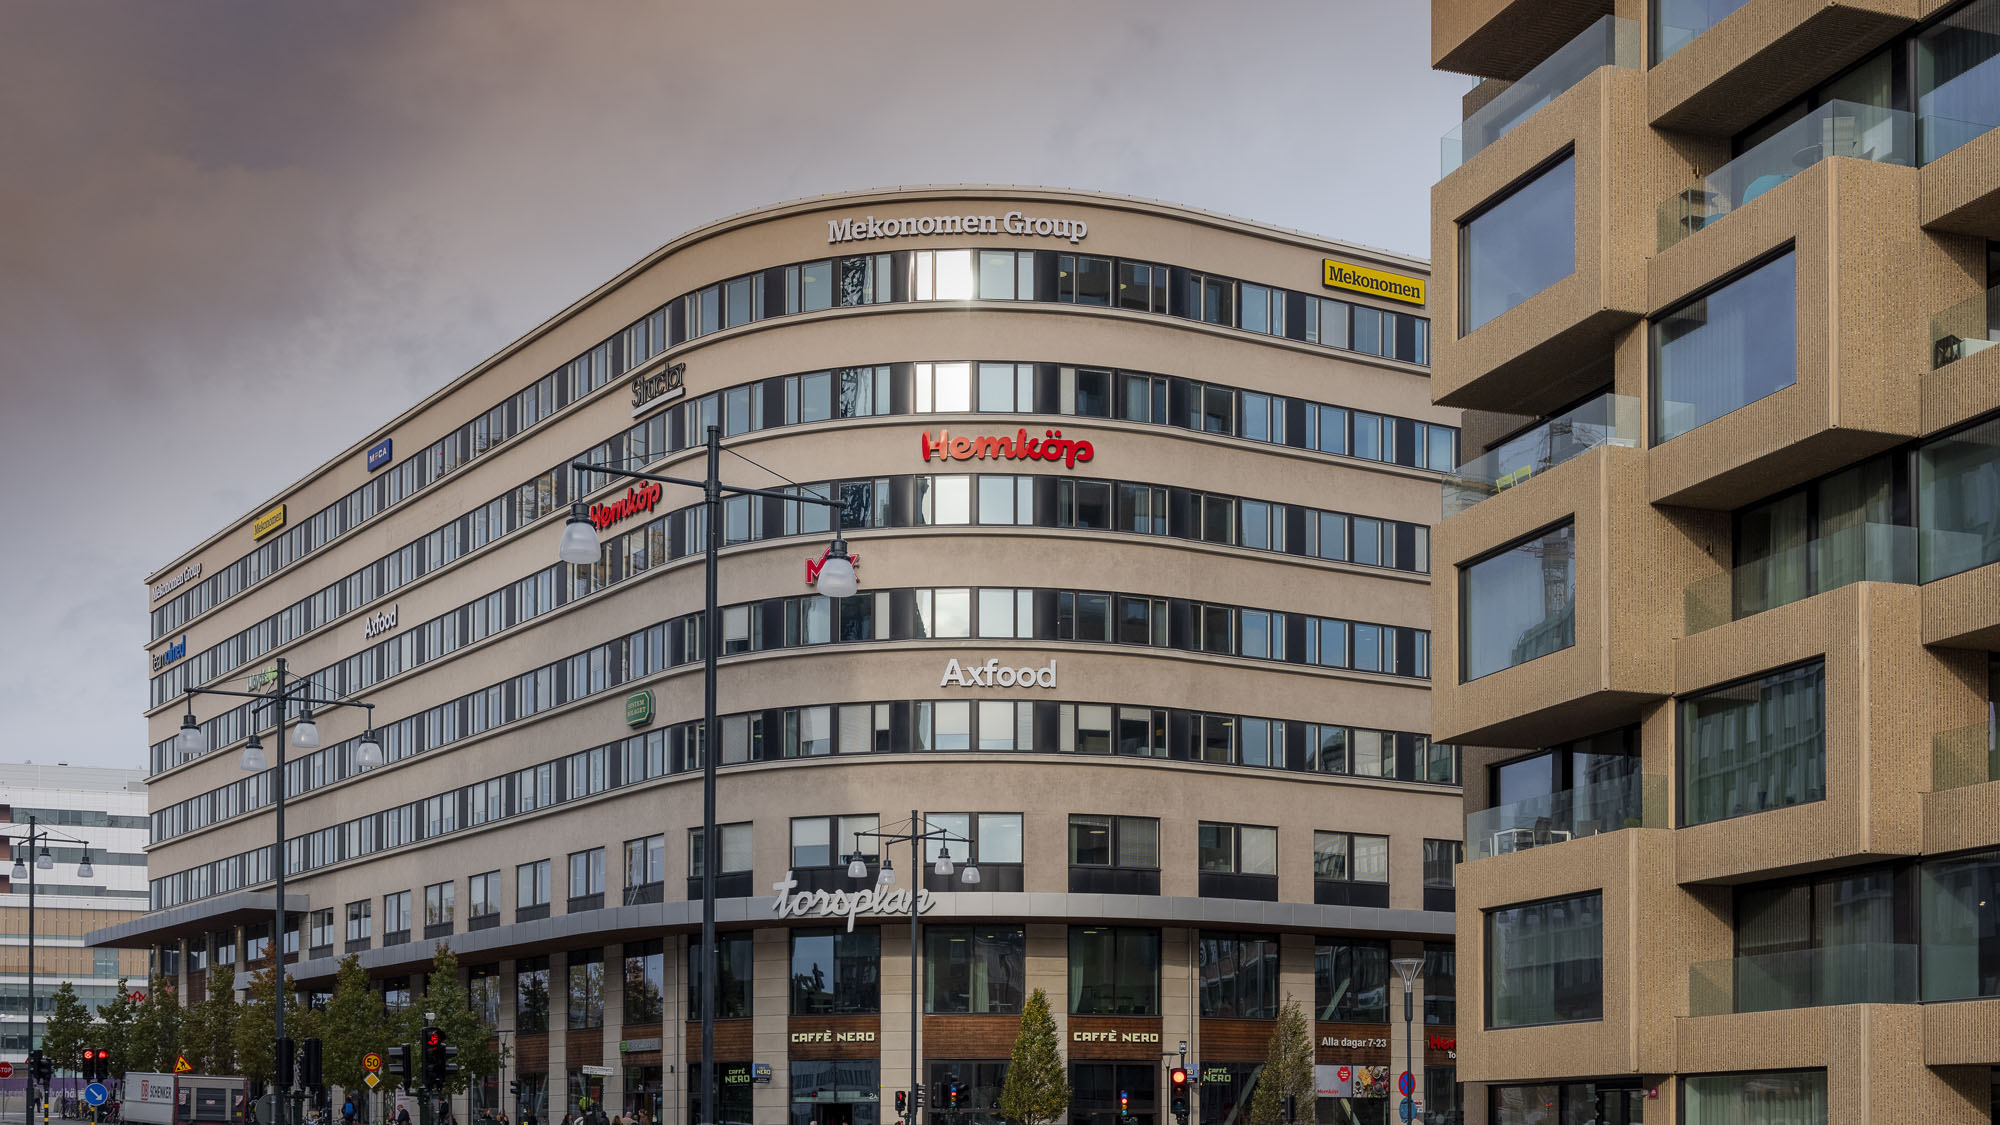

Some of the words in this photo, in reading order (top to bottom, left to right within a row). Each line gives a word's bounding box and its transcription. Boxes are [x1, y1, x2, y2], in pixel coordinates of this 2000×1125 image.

[827, 215, 998, 243] Mekonomen
[1003, 211, 1088, 243] Group
[1329, 265, 1421, 299] Mekonomen
[632, 361, 686, 408] Structor
[922, 428, 1094, 469] Hemköp
[590, 480, 663, 530] Hemköp
[254, 511, 282, 536] Mekonomen
[365, 603, 398, 639] Axfood
[941, 658, 1057, 688] Axfood
[772, 870, 936, 933] torsplan
[791, 1030, 832, 1043] CAFFÈ
[836, 1032, 875, 1042] NERO
[1073, 1030, 1117, 1042] CAFFÈ
[1122, 1032, 1159, 1043] NERO
[1321, 1037, 1339, 1047] Alla
[1341, 1037, 1366, 1049] dagar
[1368, 1038, 1387, 1048] 7-23
[366, 1058, 379, 1067] 50
[150, 1084, 172, 1098] SCHENKER
[724, 1075, 751, 1084] NERO
[1203, 1074, 1232, 1083] NERO
